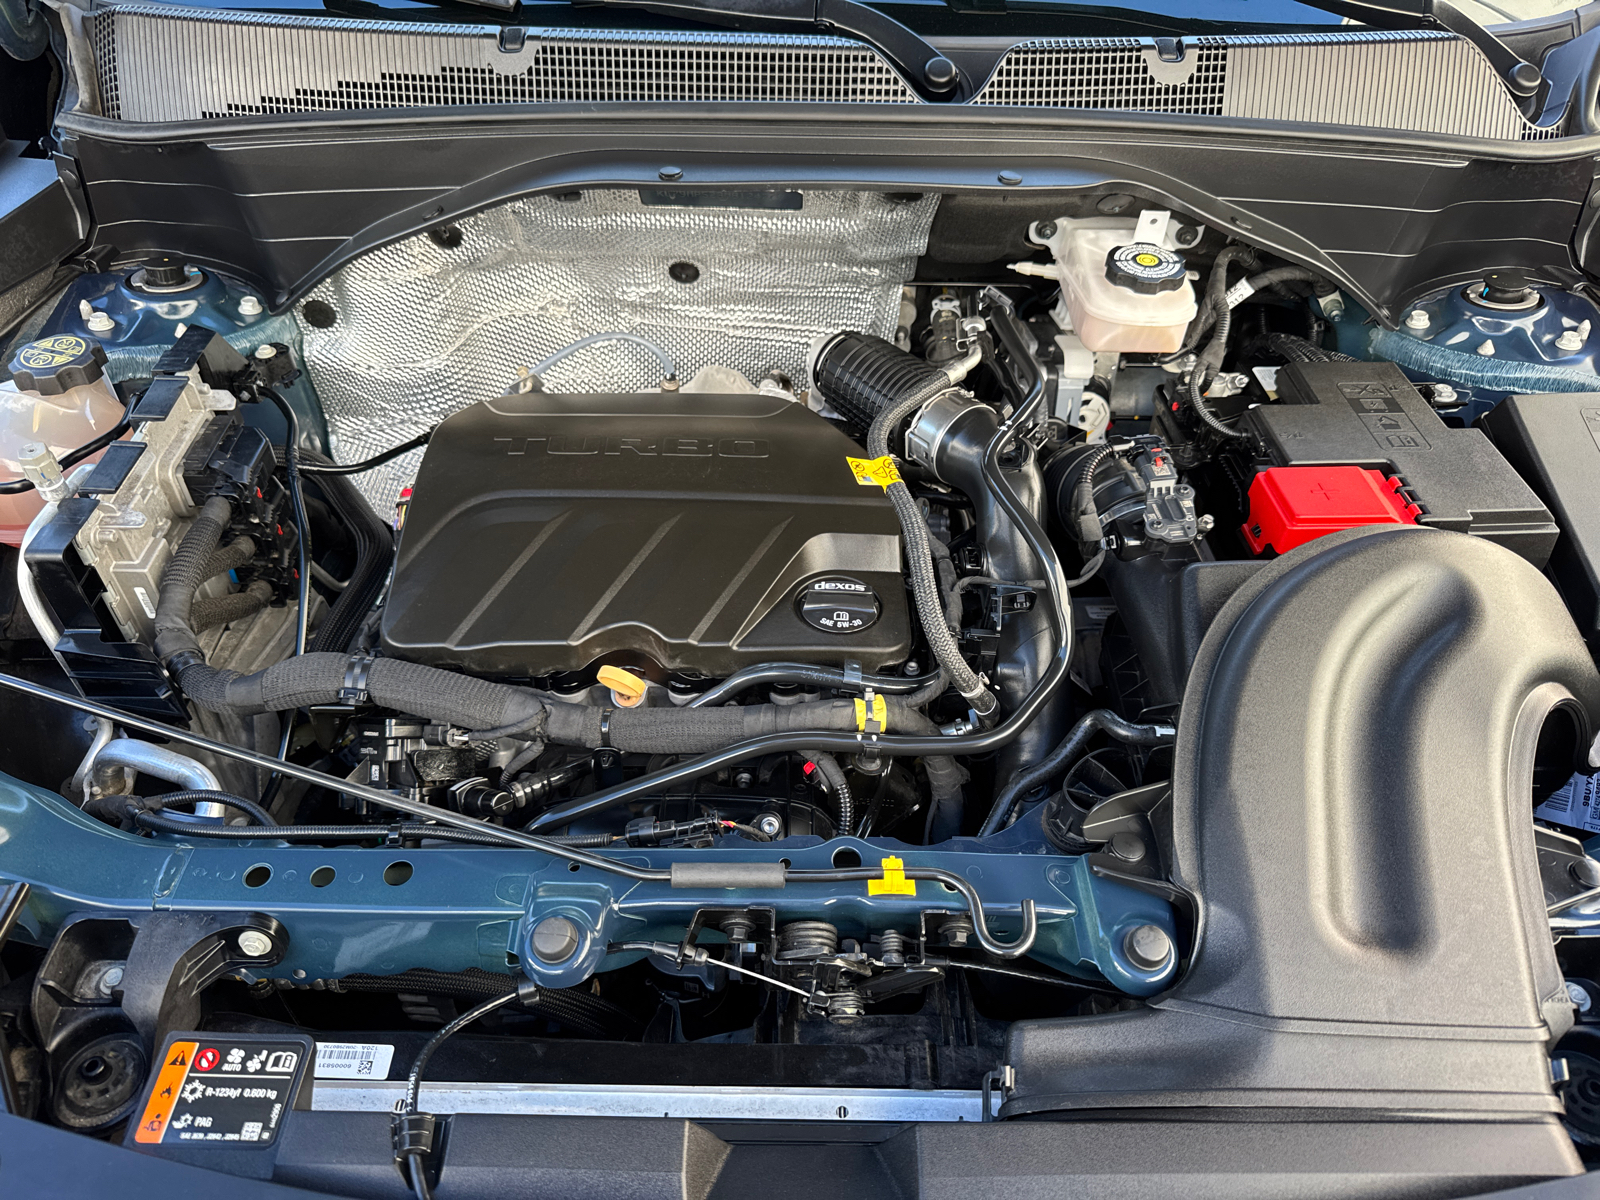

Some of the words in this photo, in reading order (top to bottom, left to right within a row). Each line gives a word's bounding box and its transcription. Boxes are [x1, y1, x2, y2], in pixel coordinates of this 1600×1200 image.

[493, 435, 770, 458] TURBO
[814, 581, 867, 592] dexos
[819, 617, 835, 627] SAE
[836, 618, 863, 628] 5W-30
[221, 1063, 242, 1072] AUTO
[204, 1086, 243, 1099] R-1234yf
[242, 1087, 267, 1098] 0.600
[266, 1088, 278, 1100] kg
[193, 1116, 213, 1128] PAG
